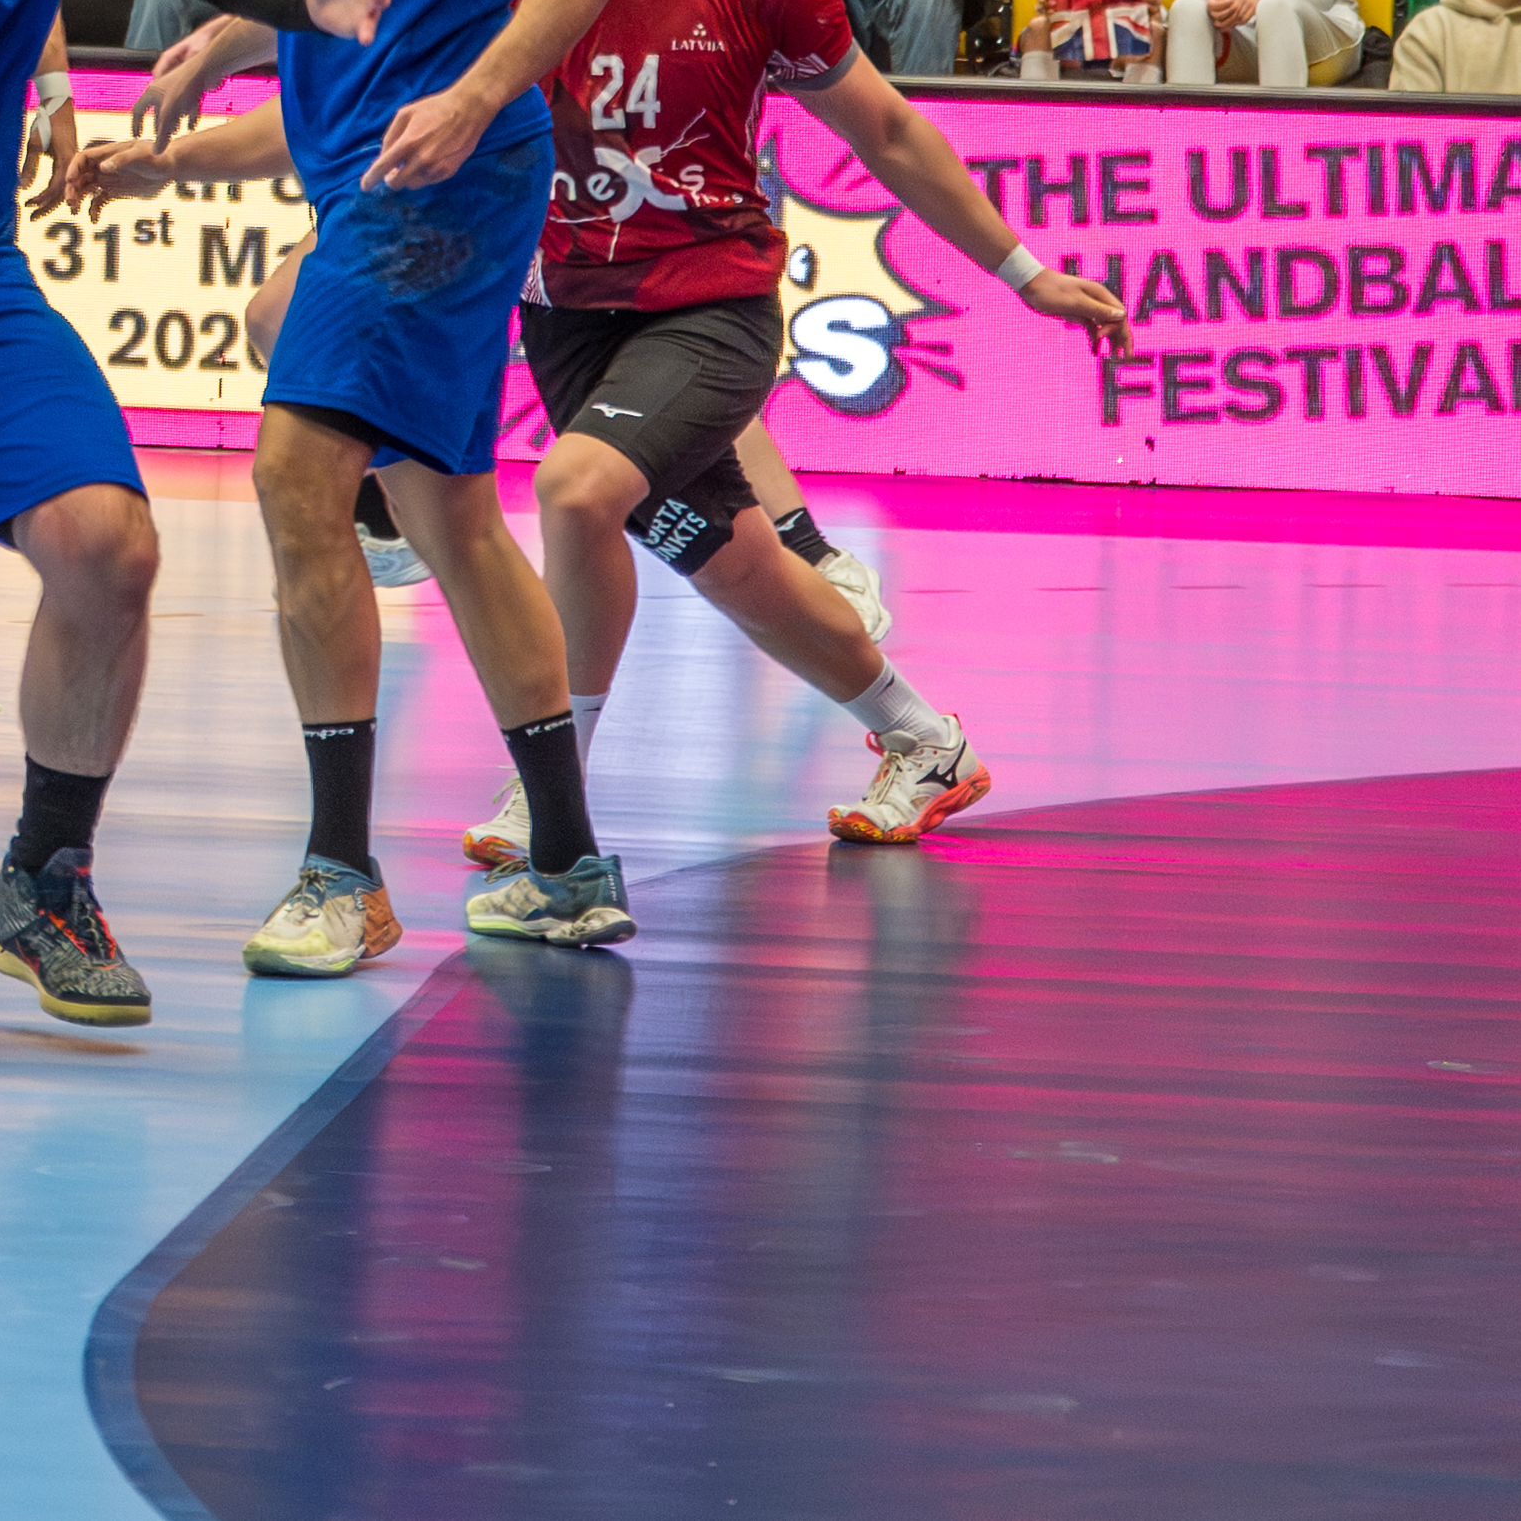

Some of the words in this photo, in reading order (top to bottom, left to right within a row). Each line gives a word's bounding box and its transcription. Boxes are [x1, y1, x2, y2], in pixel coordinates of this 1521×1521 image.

[590, 53, 662, 131] 24
[39, 210, 176, 283] 31st
[1100, 341, 1521, 425] FESTIVA
